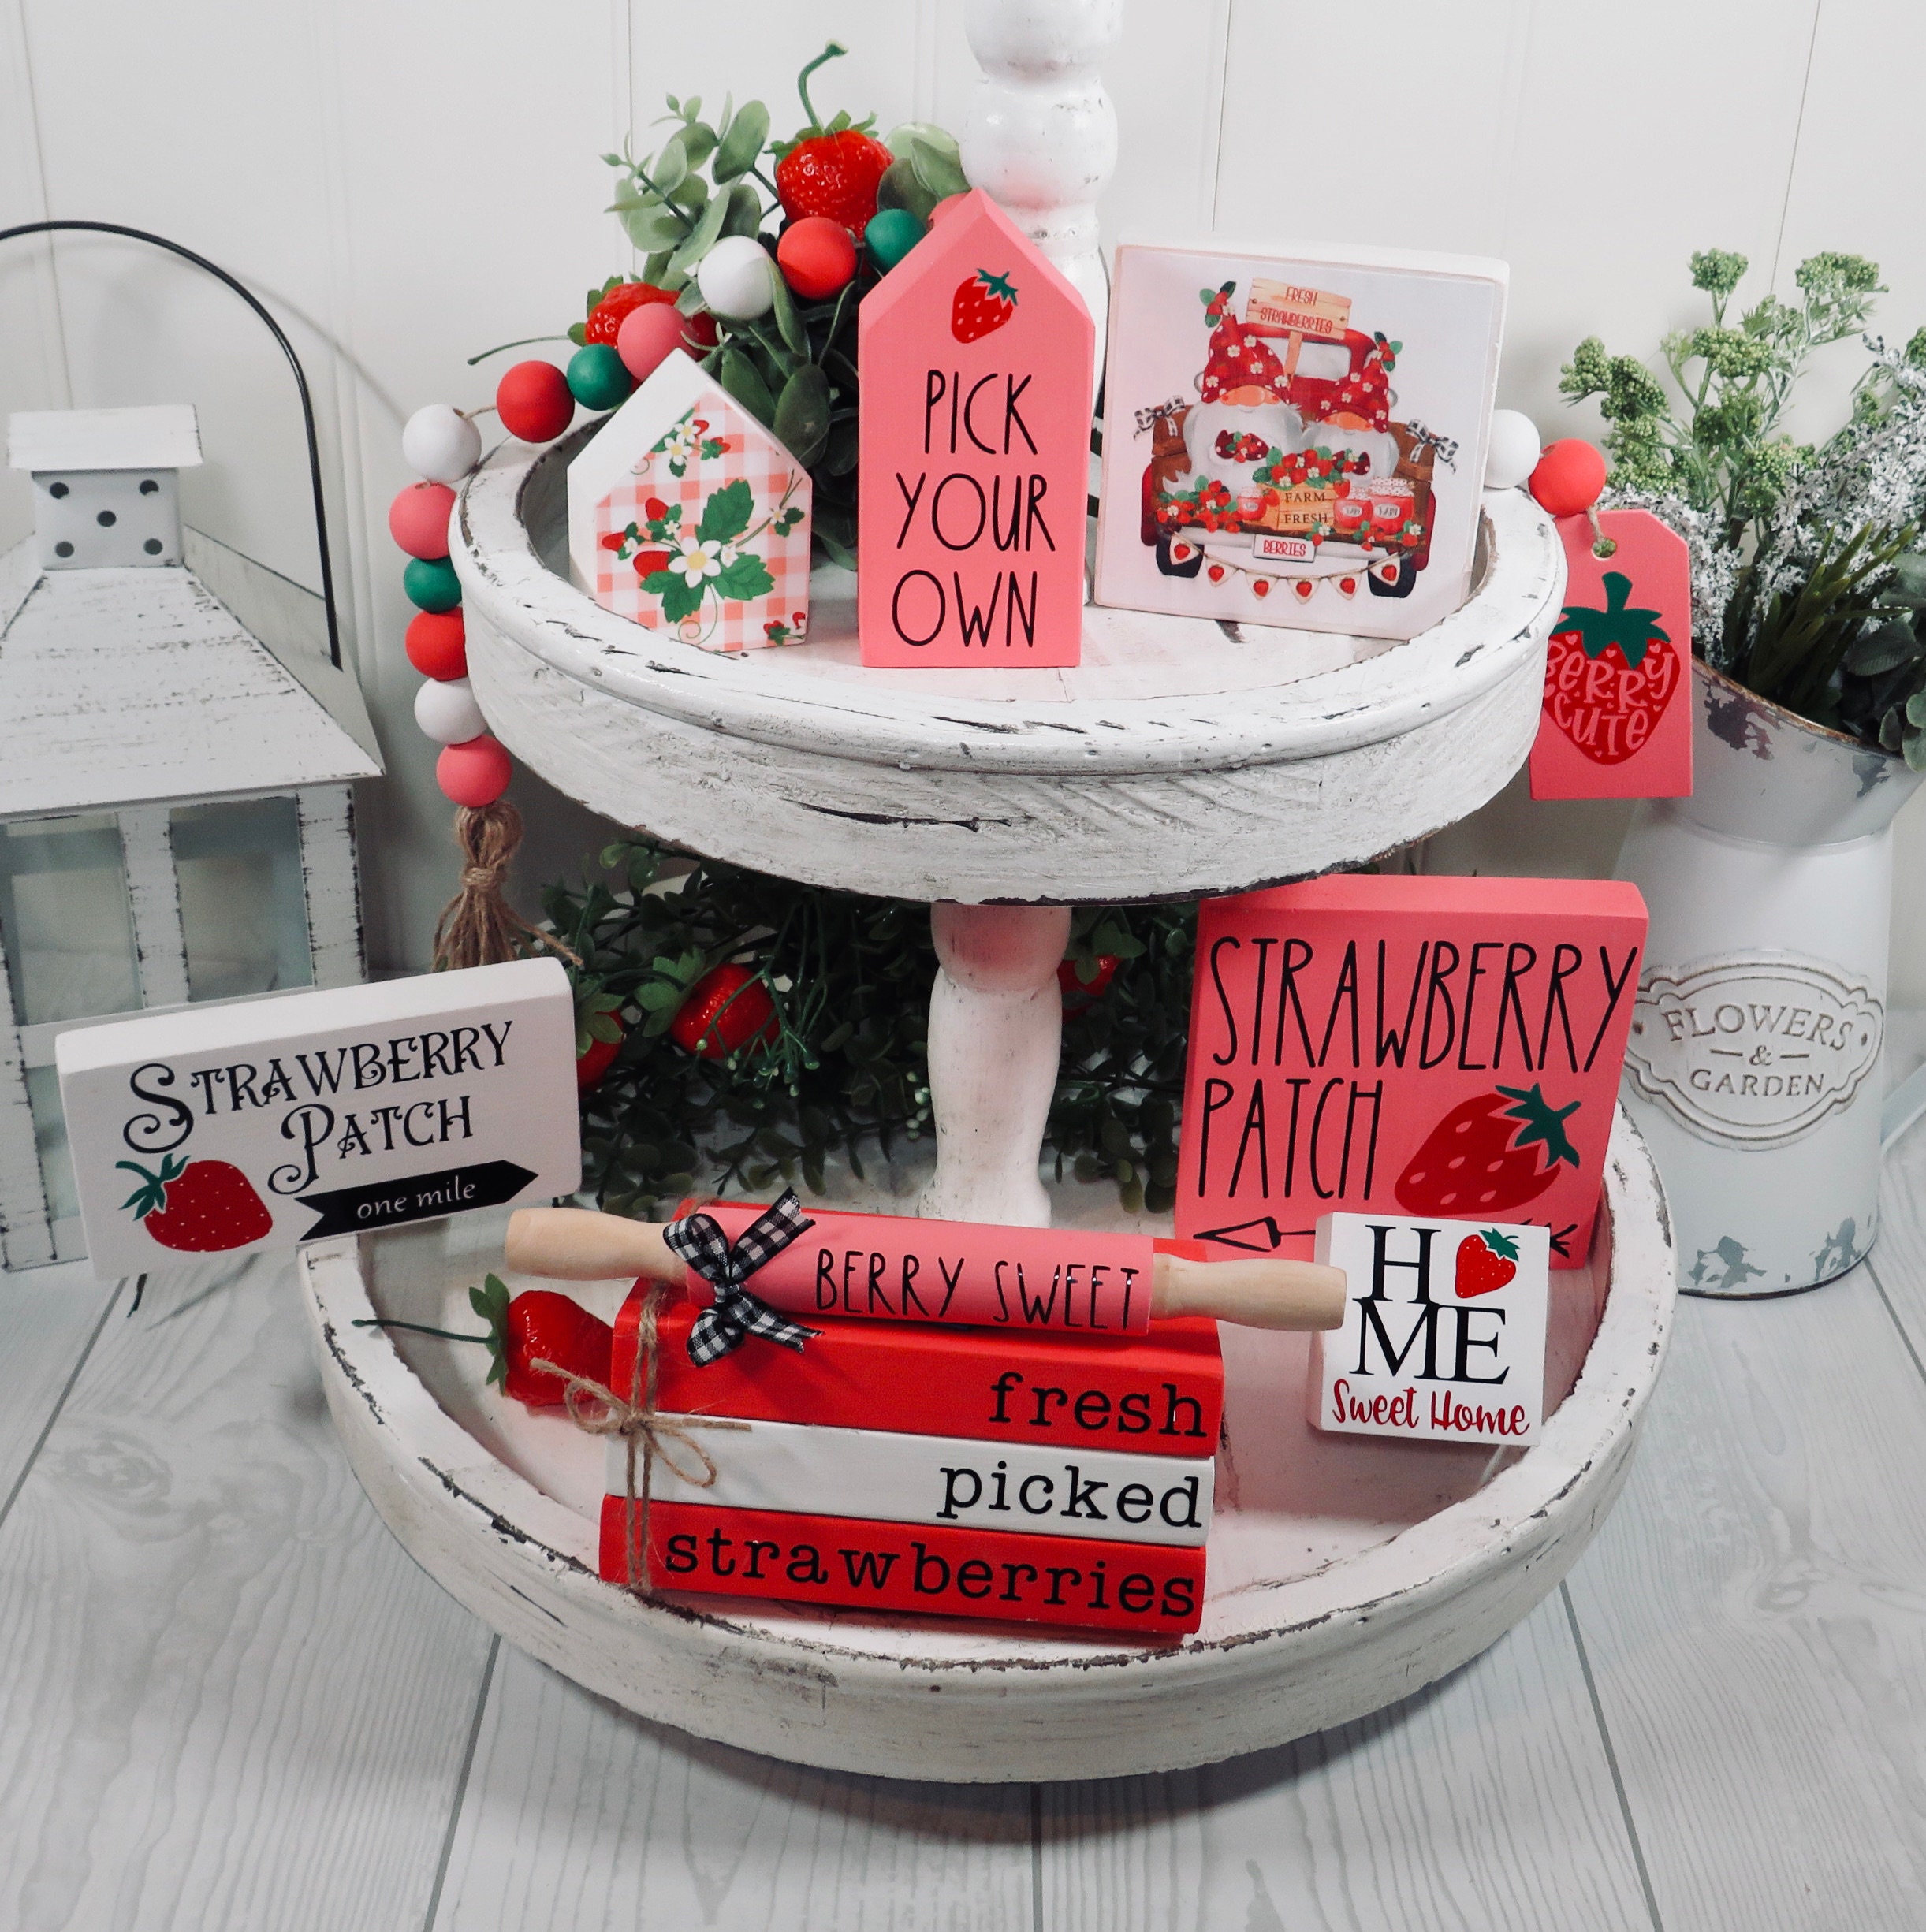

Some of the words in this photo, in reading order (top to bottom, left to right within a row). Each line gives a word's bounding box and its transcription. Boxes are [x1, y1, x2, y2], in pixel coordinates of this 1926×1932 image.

[1260, 307, 1333, 334] STRAWBERRIES
[1286, 286, 1318, 306] FRESH
[924, 369, 1038, 455] PICK
[896, 472, 1056, 552] YOUR
[1284, 512, 1328, 523] FRESH
[1285, 492, 1325, 503] FARM
[1263, 539, 1306, 557] BERRIES
[892, 569, 1038, 648] OWN
[1209, 936, 1638, 1073] STRAWBERRY
[1661, 1003, 1853, 1051] FLOWERS
[122, 1020, 514, 1154] STRAWBERRY
[1689, 1068, 1825, 1096] GARDEN
[1749, 1044, 1773, 1066] &
[267, 1096, 474, 1195] PATCH
[1198, 1078, 1384, 1201] PATCH
[357, 1197, 407, 1219] one
[415, 1174, 476, 1212] mile
[816, 1248, 965, 1319] BERRY
[994, 1260, 1140, 1331] SWEET
[989, 1372, 1208, 1439] fresh
[1332, 1378, 1419, 1429] Sweet
[1430, 1390, 1530, 1436] Home
[937, 1461, 1203, 1528] picked
[665, 1528, 1197, 1618] strawberries
